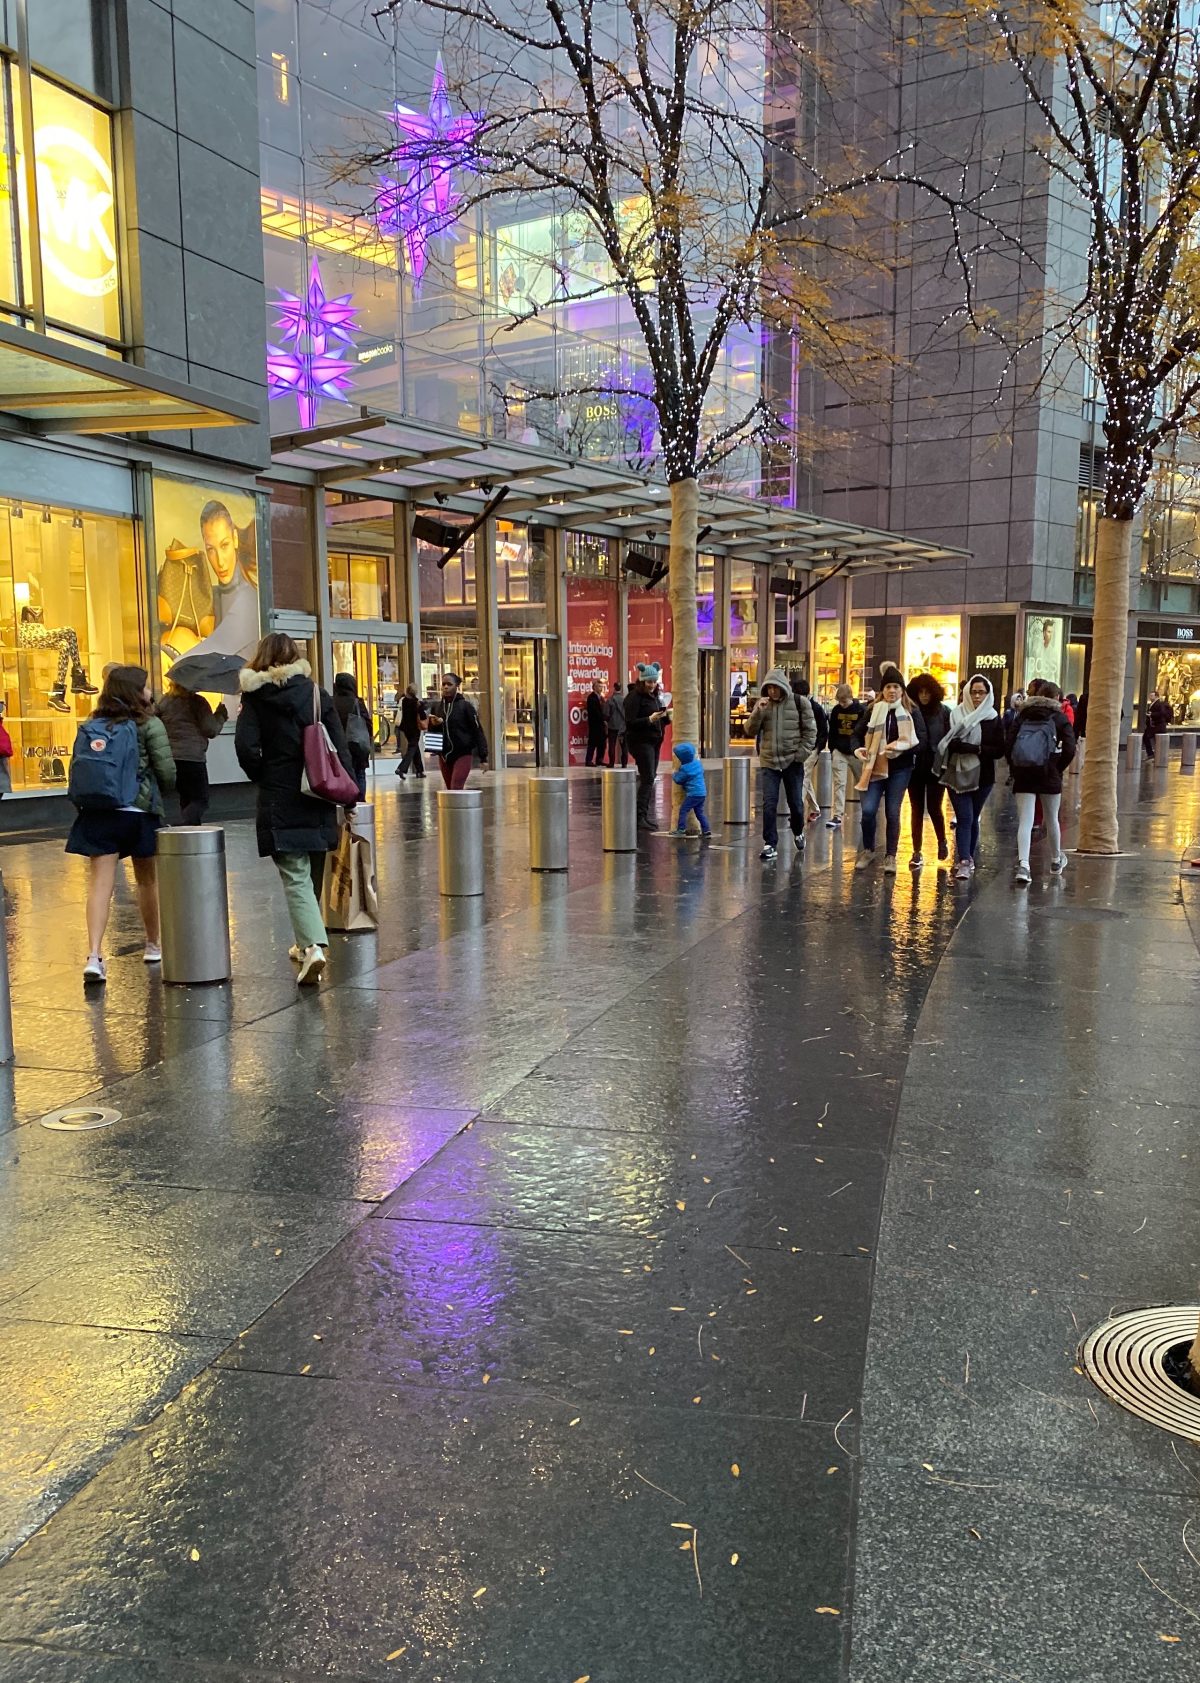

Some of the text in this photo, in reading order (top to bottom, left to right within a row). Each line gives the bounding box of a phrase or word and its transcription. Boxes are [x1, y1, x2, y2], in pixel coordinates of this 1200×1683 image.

[35, 160, 115, 262] MK
[586, 403, 617, 418] BOSS
[1177, 628, 1194, 636] BOSS
[568, 641, 613, 658] Introducing
[568, 656, 597, 666] a more
[976, 655, 1007, 665] BOSS
[569, 667, 609, 681] rewarding
[570, 736, 584, 745] Join
[23, 745, 71, 758] MICHAEL
